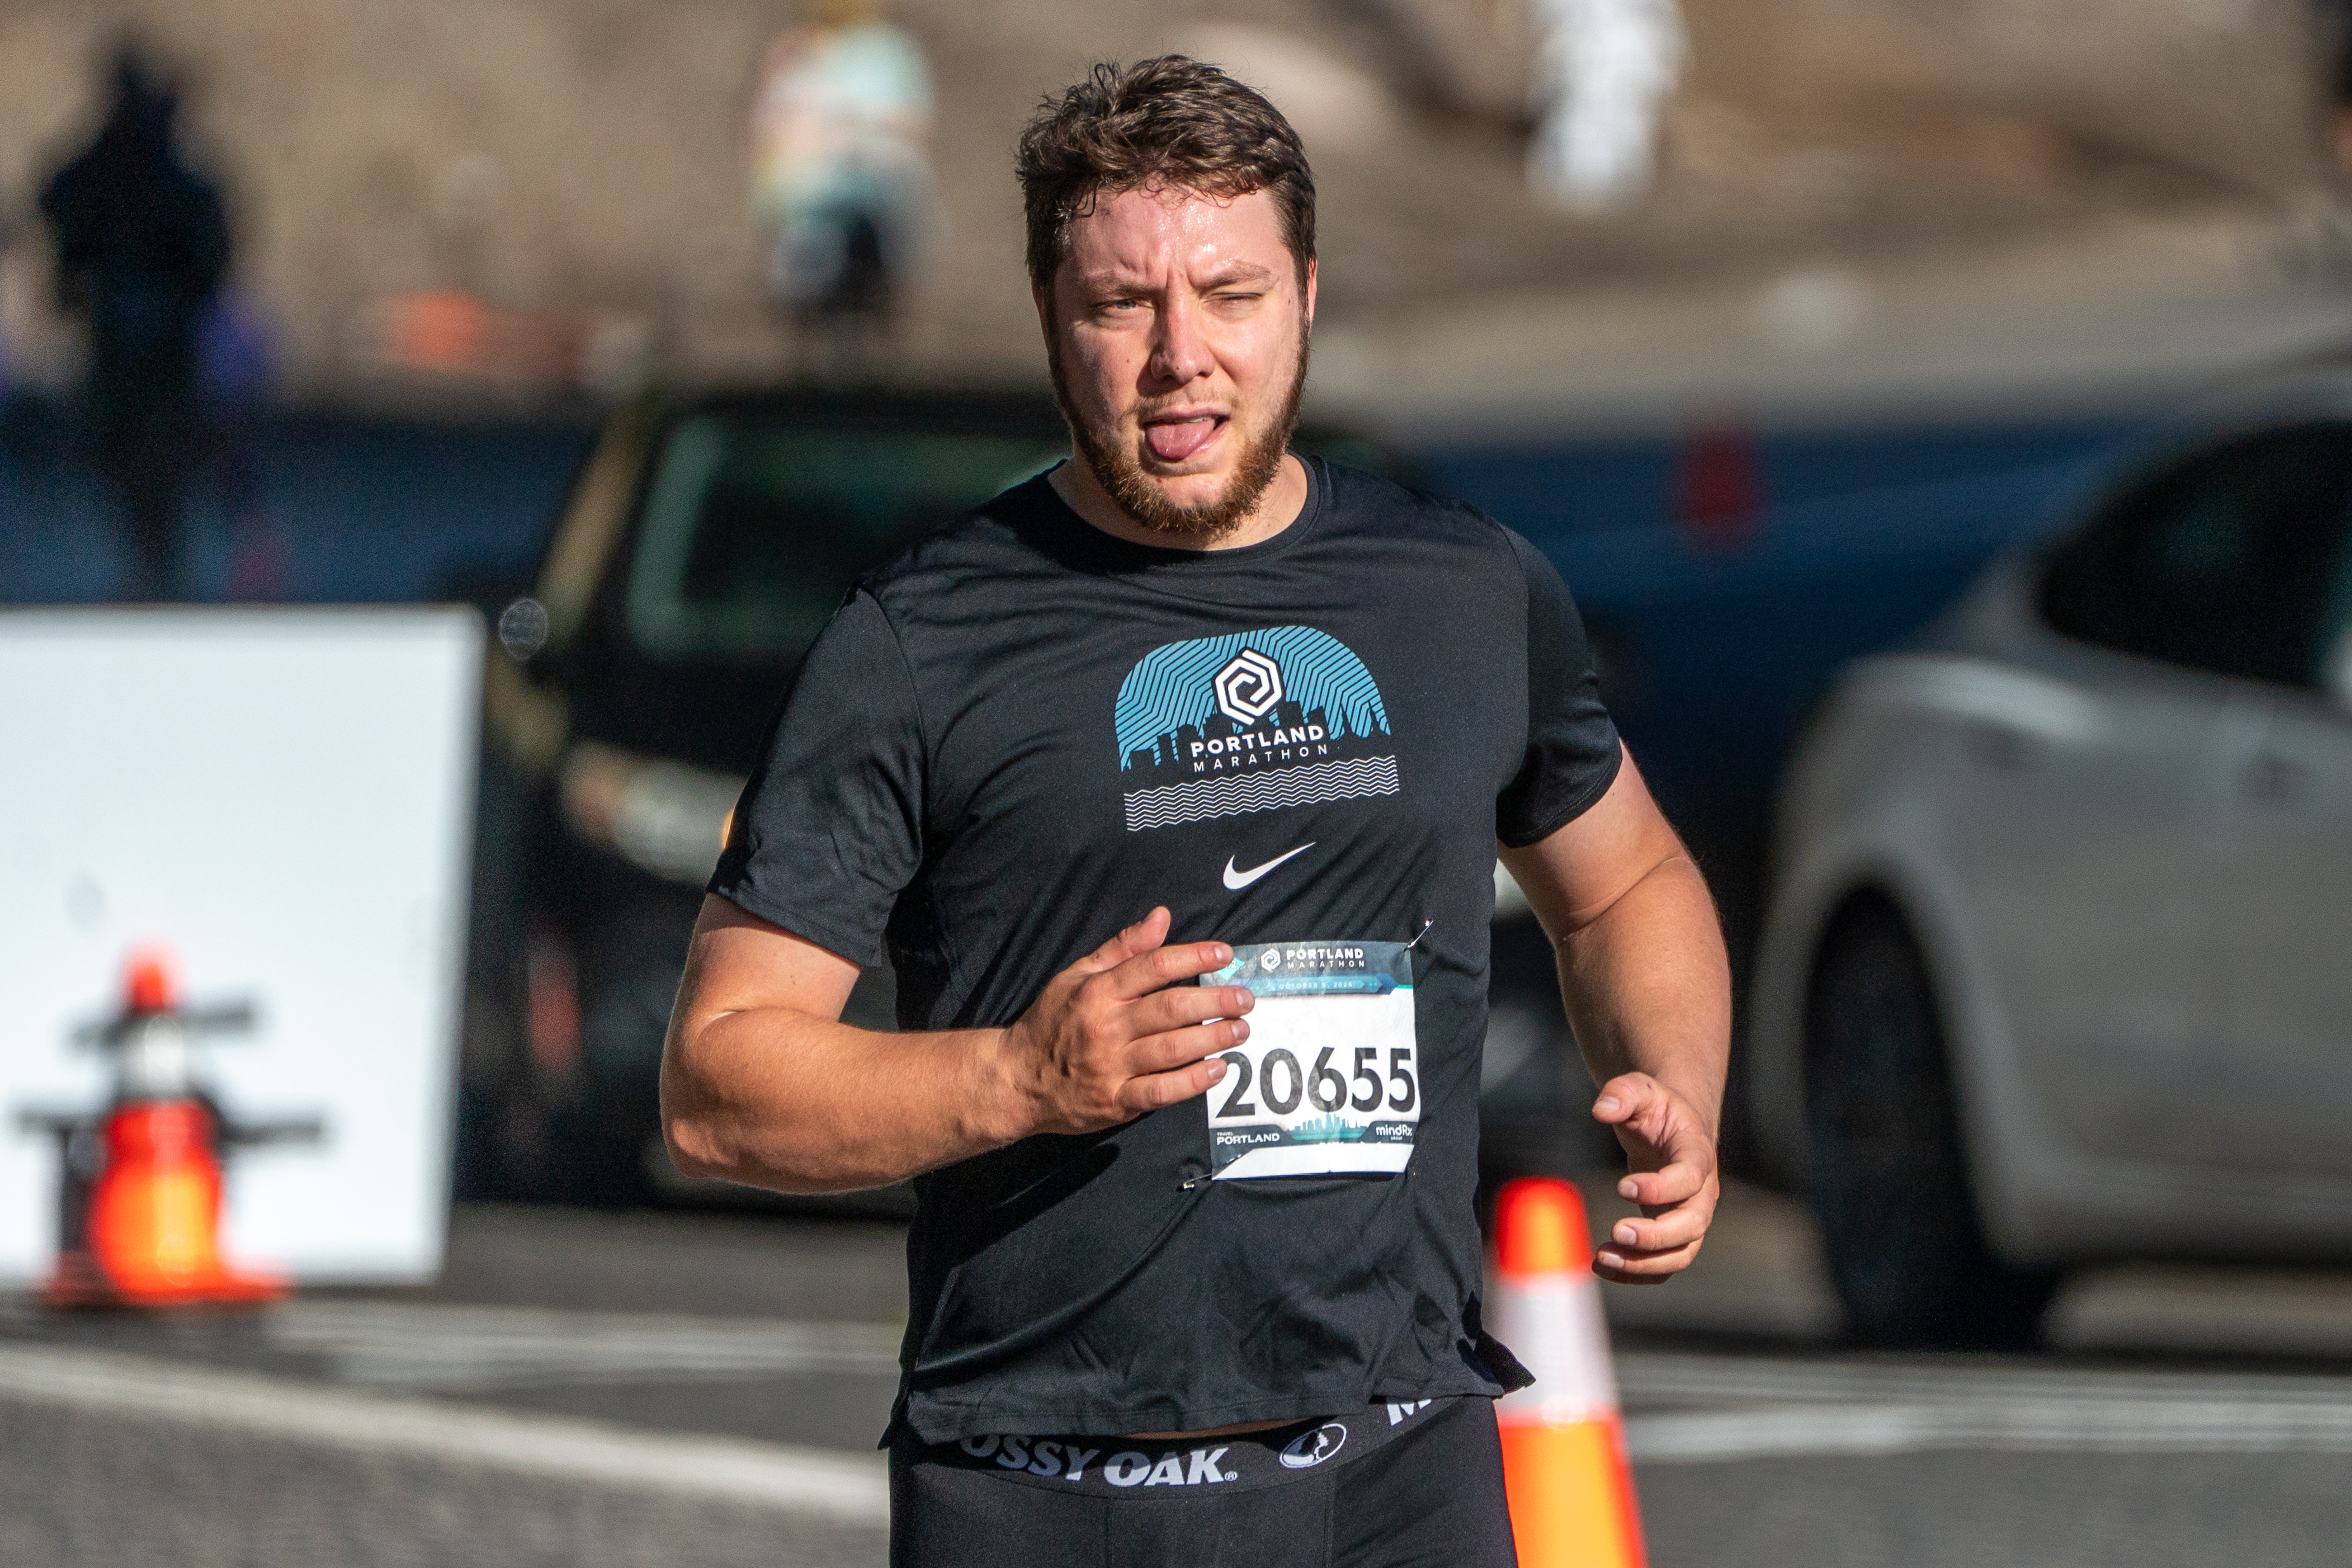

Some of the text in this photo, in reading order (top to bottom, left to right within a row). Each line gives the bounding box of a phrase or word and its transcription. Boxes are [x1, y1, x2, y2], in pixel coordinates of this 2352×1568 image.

[1190, 725, 1324, 758] PORTLAND
[1193, 744, 1327, 772] MARATHON
[1286, 948, 1363, 960] PORTLAND
[1287, 960, 1365, 969] MARATHON
[1215, 1046, 1415, 1119] 20655
[1217, 1133, 1280, 1145] PORTLAND
